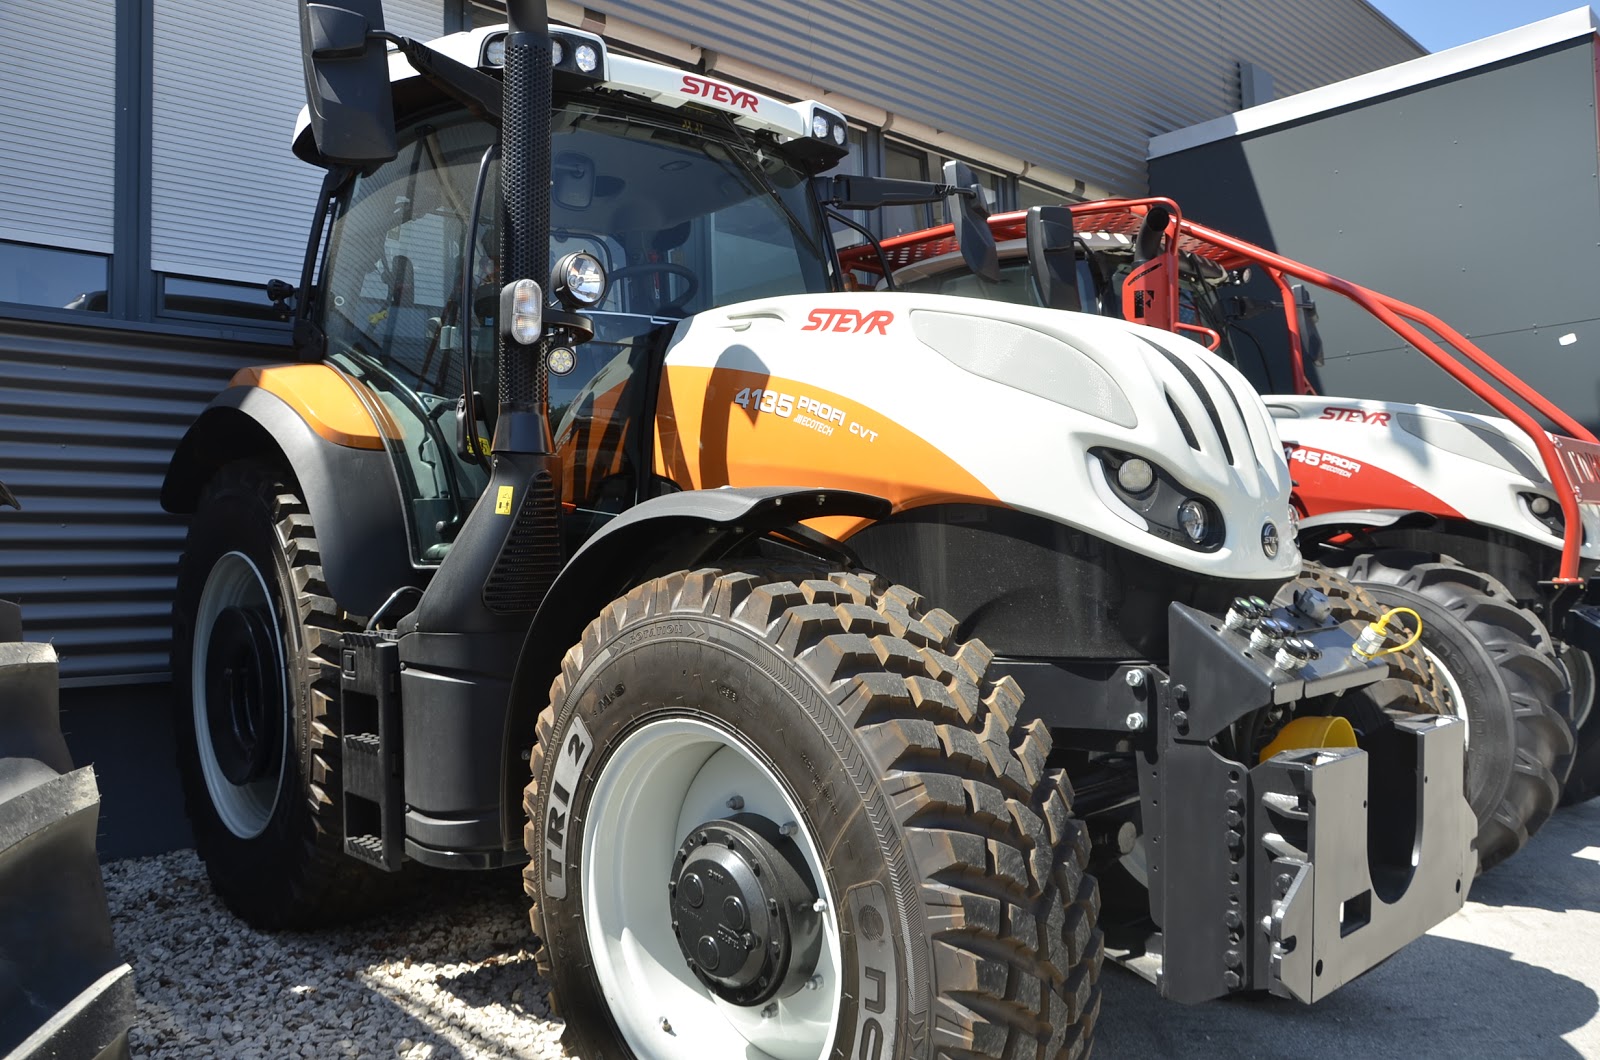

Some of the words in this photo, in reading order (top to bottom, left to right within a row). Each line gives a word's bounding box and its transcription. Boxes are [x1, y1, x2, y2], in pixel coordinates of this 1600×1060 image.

[680, 75, 759, 113] STEYR
[800, 308, 895, 336] STEYR
[734, 387, 795, 418] 4135
[796, 395, 847, 427] PROFI
[1318, 407, 1391, 427] STEYR
[800, 417, 834, 437] ECOTECH
[848, 421, 879, 443] CVT
[1321, 452, 1361, 473] PROFI
[629, 623, 683, 645] ROTATION
[546, 779, 571, 884] TRI
[567, 733, 586, 768] 2
